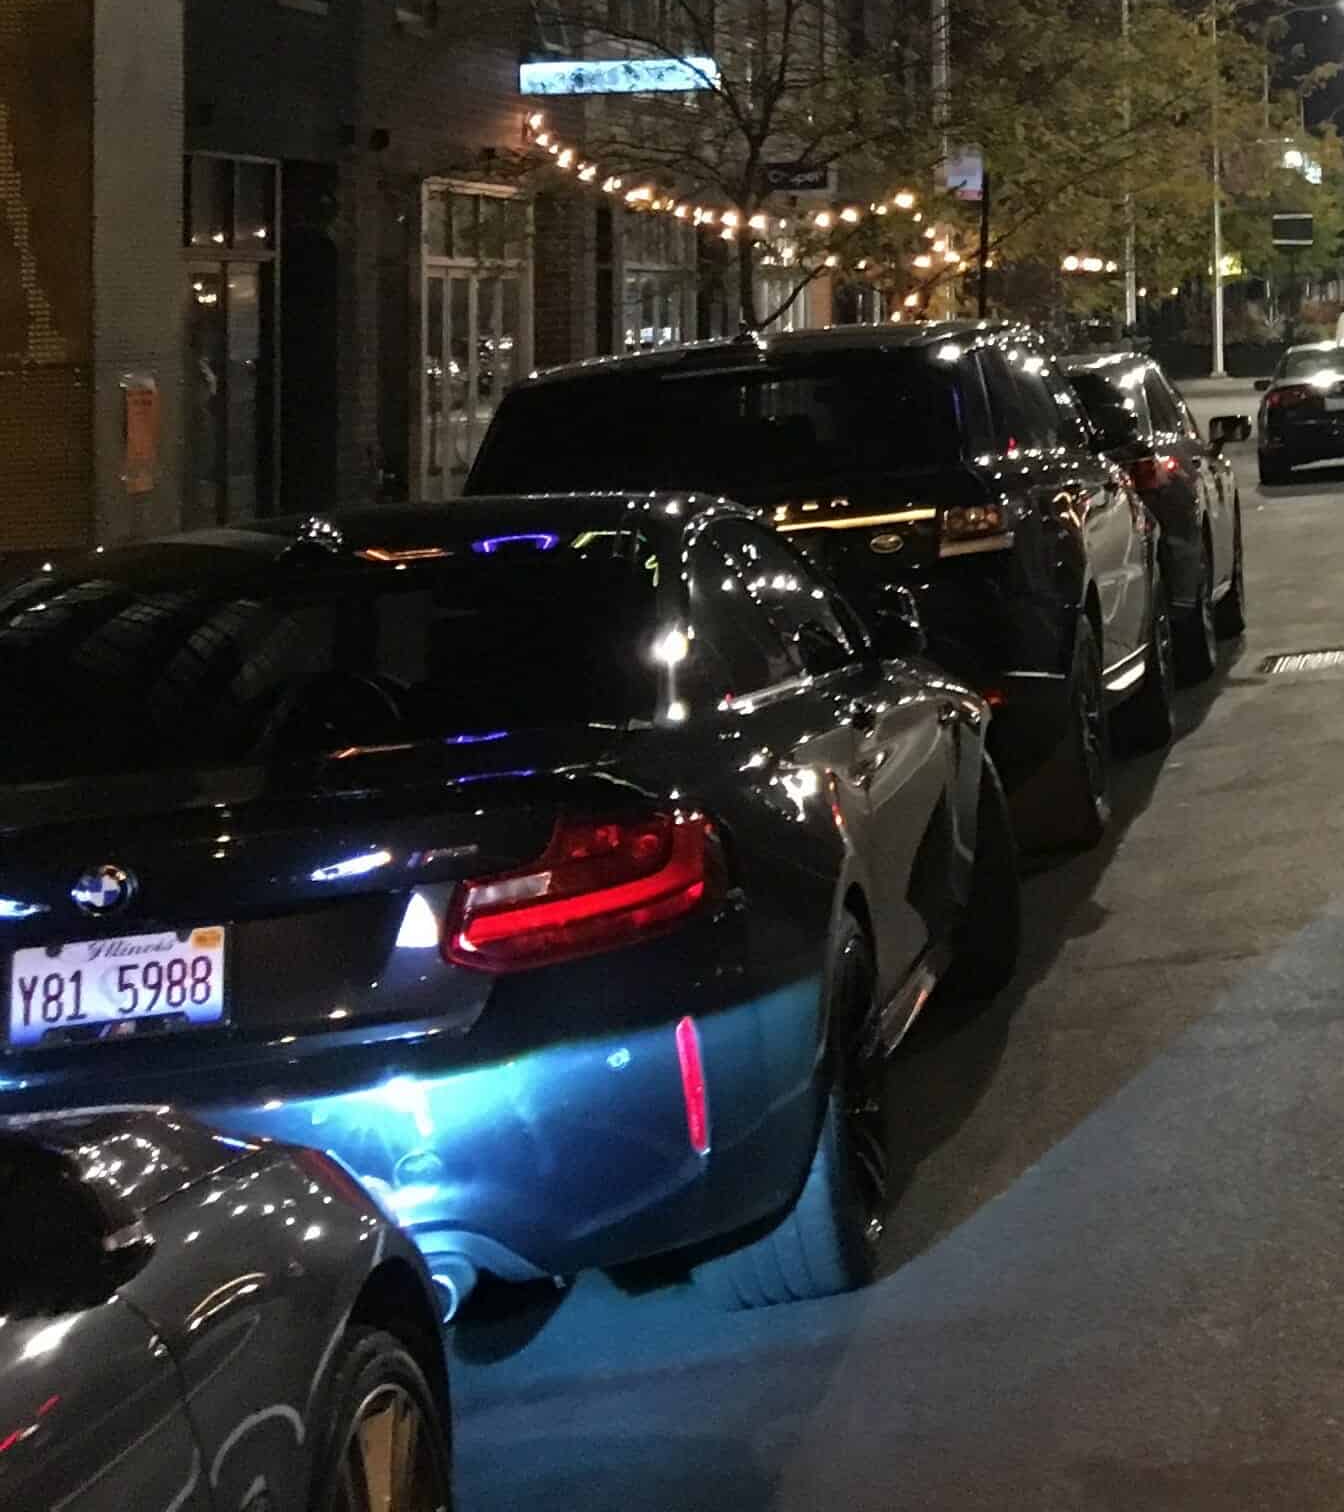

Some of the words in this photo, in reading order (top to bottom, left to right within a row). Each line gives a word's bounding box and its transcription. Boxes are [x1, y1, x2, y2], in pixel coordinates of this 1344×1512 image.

[87, 939, 175, 963] Illinois
[18, 969, 88, 1027] Y81
[117, 955, 213, 1015] 5988
